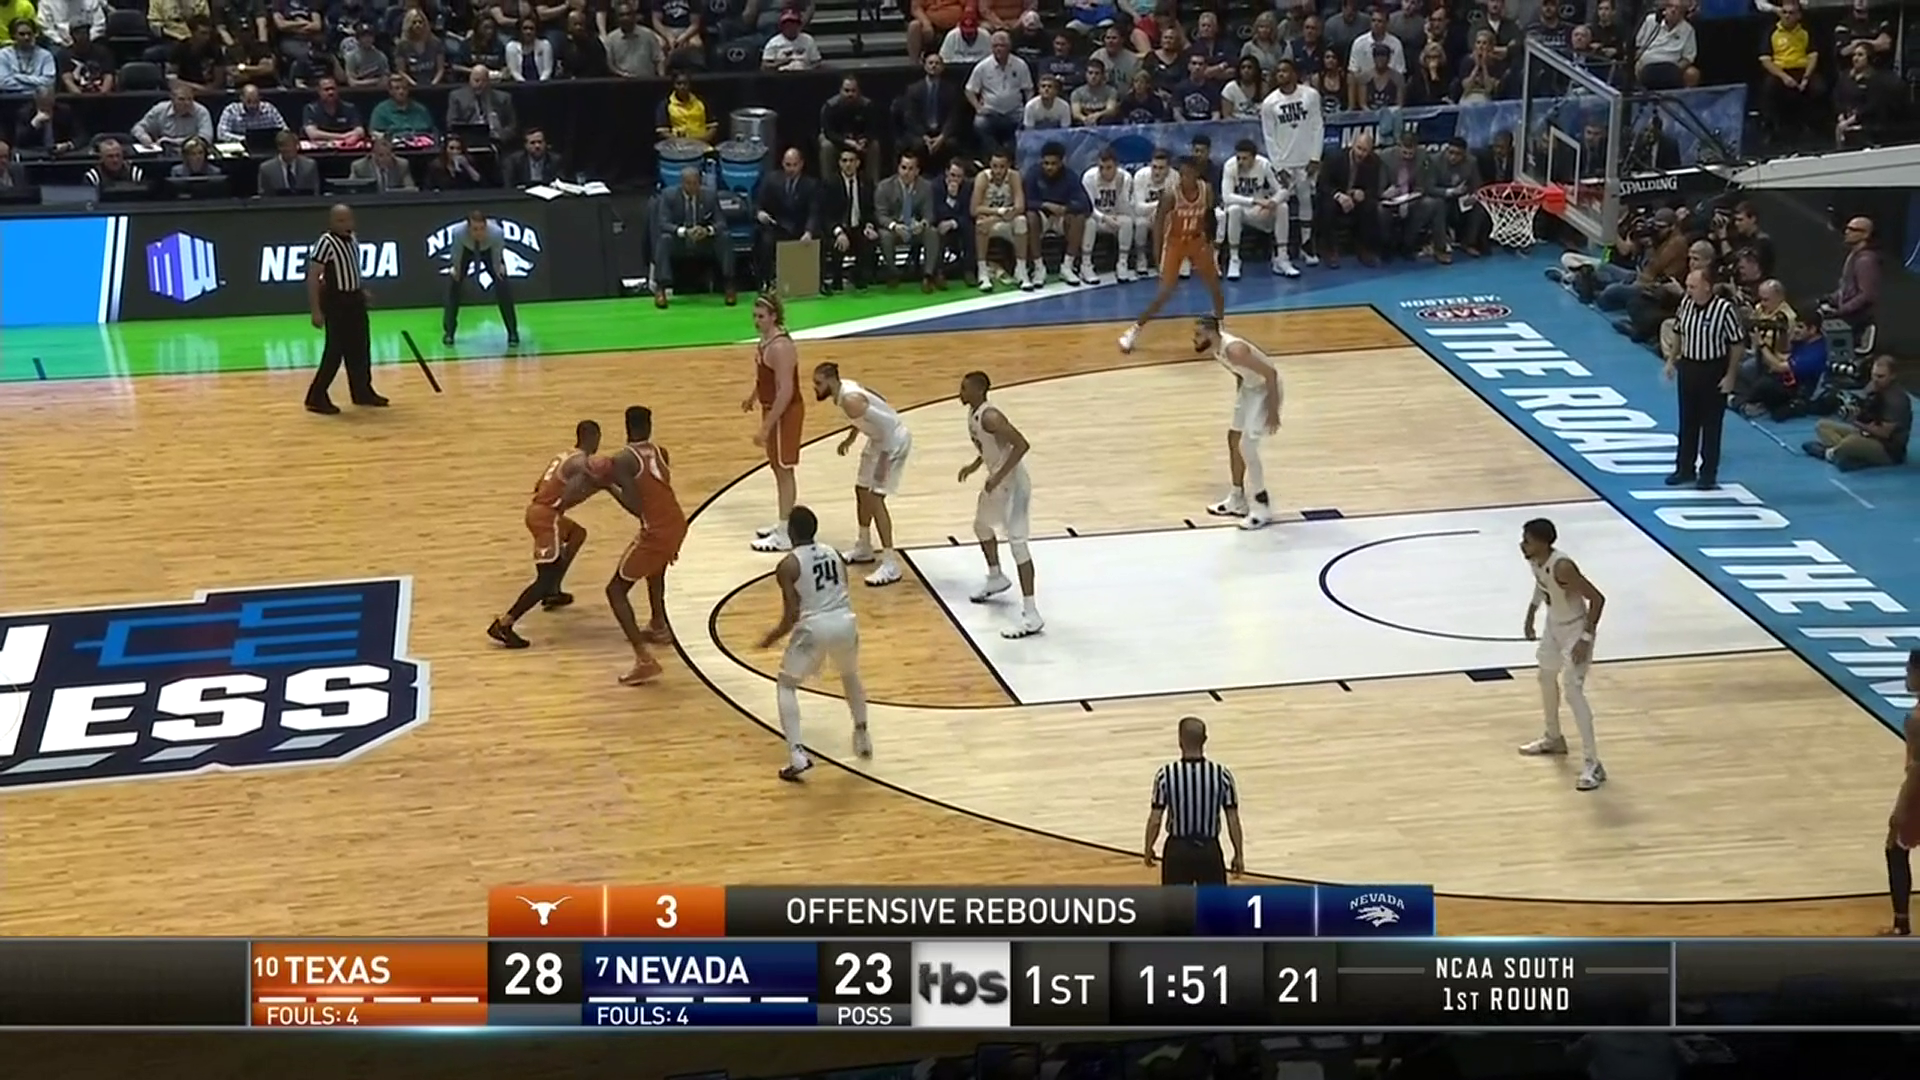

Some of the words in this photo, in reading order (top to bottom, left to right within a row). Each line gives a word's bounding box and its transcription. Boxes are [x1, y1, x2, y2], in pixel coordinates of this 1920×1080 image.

[1620, 176, 1677, 196] SPALDING
[1400, 297, 1469, 308] HOSTED
[1425, 321, 1594, 379] THE
[1500, 386, 1679, 474] ROAD
[1628, 483, 1791, 530] TO
[812, 559, 839, 592] 24
[1698, 540, 1909, 614] THE
